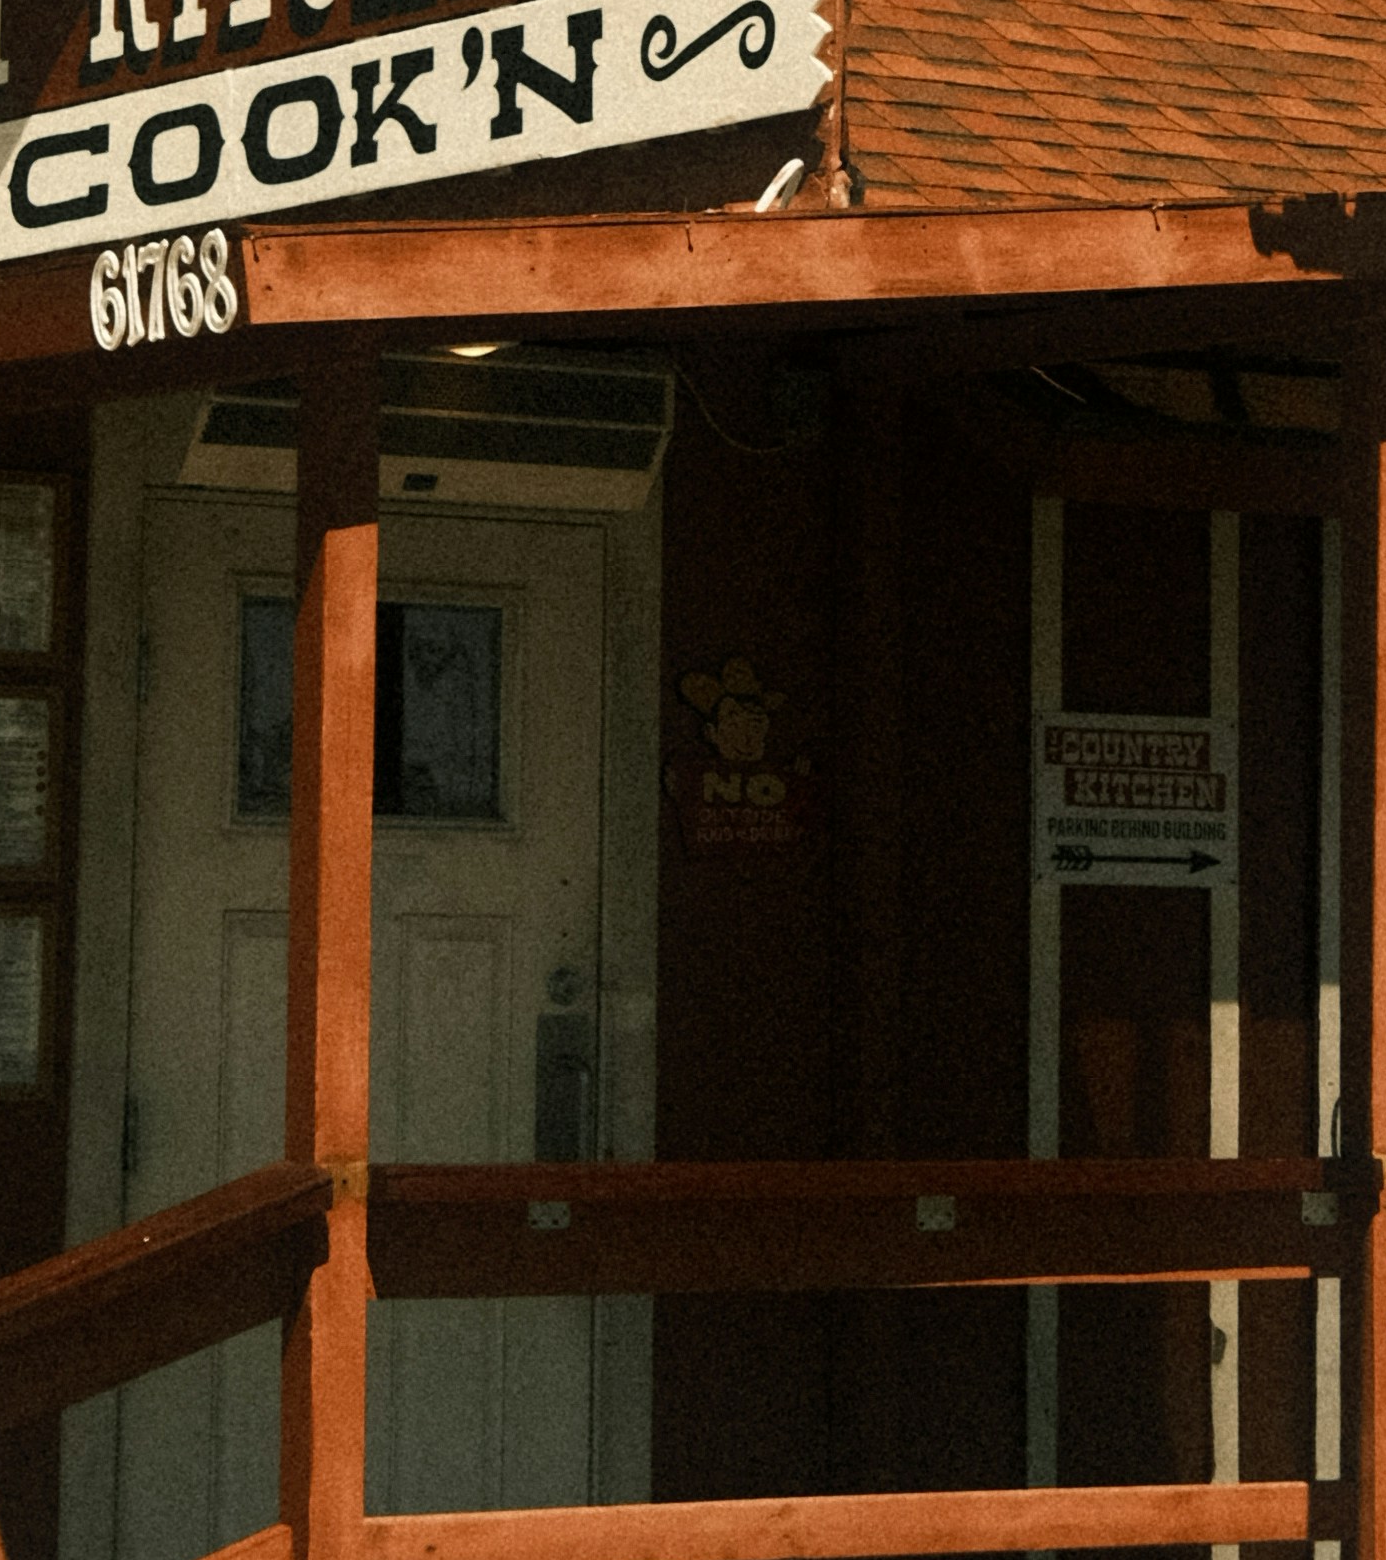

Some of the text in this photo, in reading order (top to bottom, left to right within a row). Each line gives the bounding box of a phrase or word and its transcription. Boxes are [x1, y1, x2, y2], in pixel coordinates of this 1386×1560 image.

[8, 8, 604, 229] COOK'N
[90, 227, 239, 351] 61768
[1062, 731, 1205, 767] COUNTRY
[703, 769, 787, 806] NO
[1074, 771, 1218, 807] KITCHEN
[1048, 818, 1227, 841] PARKING BEHIND BUILDING
